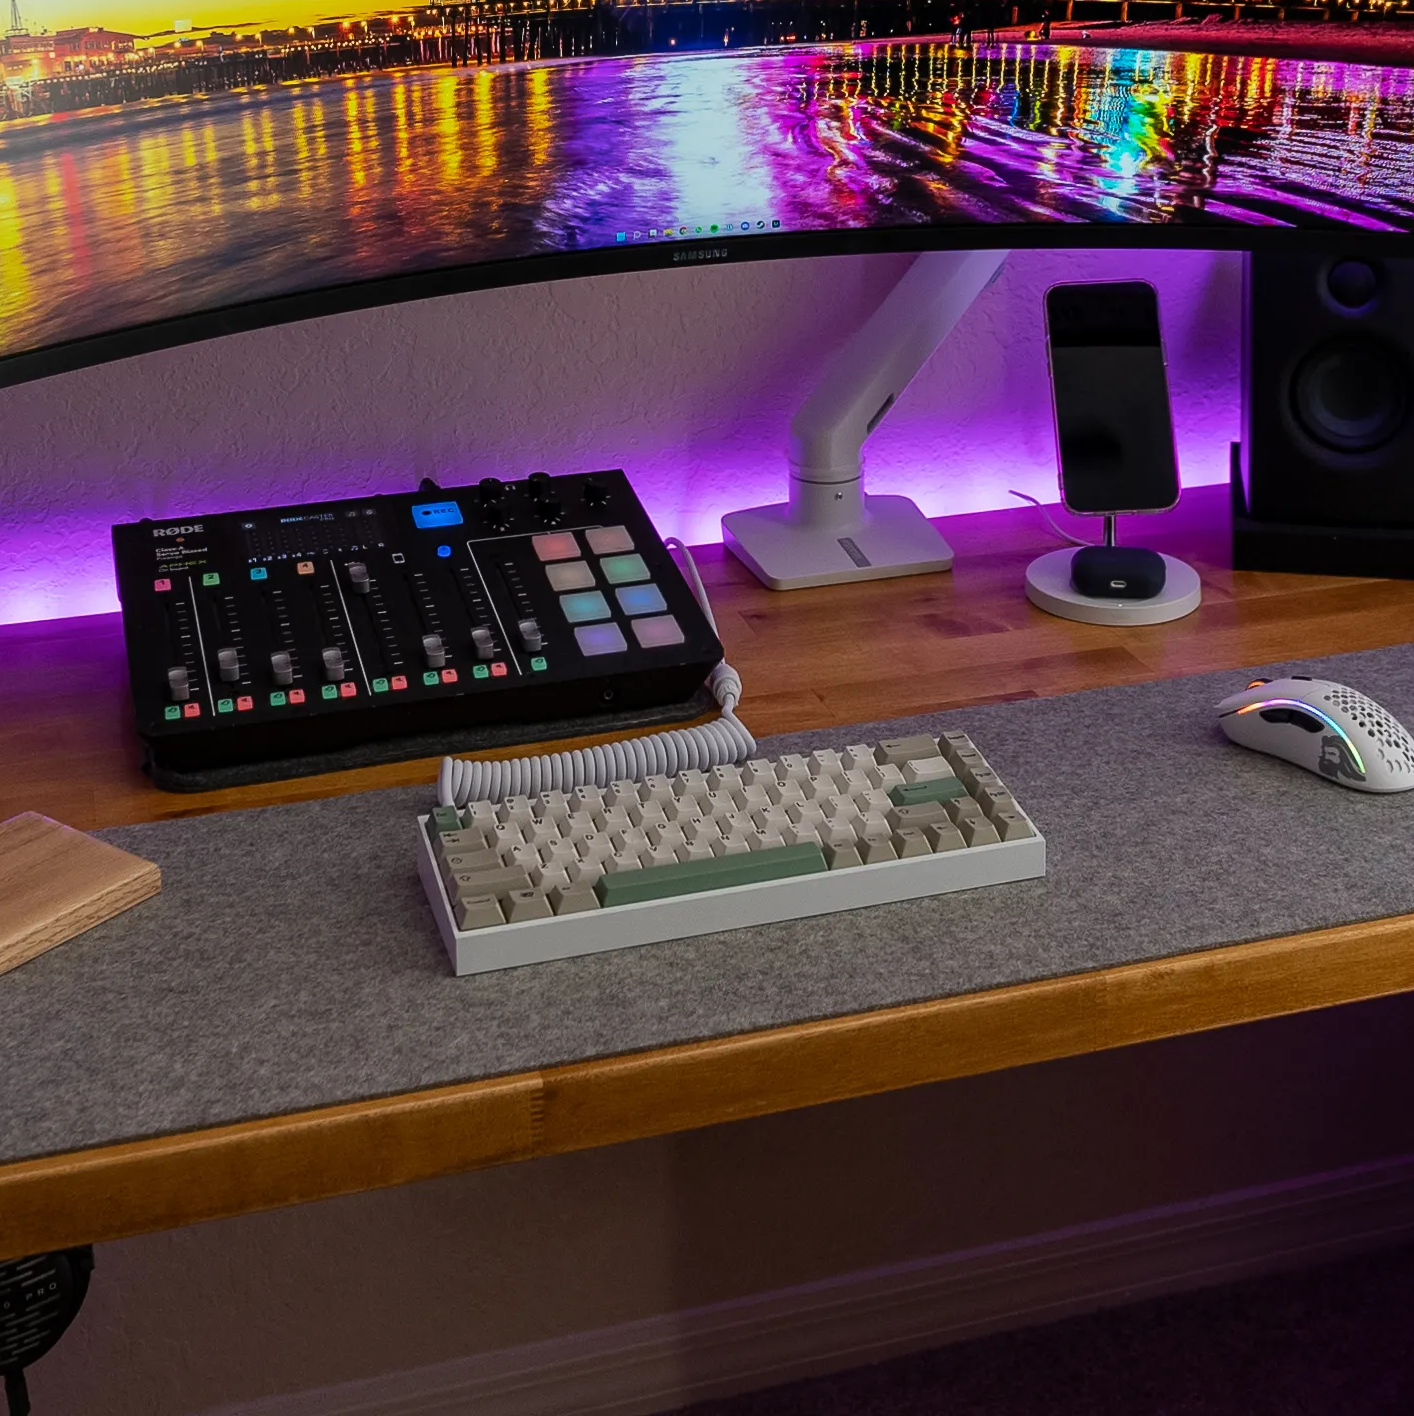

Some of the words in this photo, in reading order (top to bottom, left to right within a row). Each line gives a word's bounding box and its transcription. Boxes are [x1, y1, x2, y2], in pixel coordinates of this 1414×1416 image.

[673, 248, 728, 261] SAMSUNG
[433, 507, 455, 515] REC
[153, 524, 204, 537] RØDE
[25, 1282, 57, 1301] PRO
